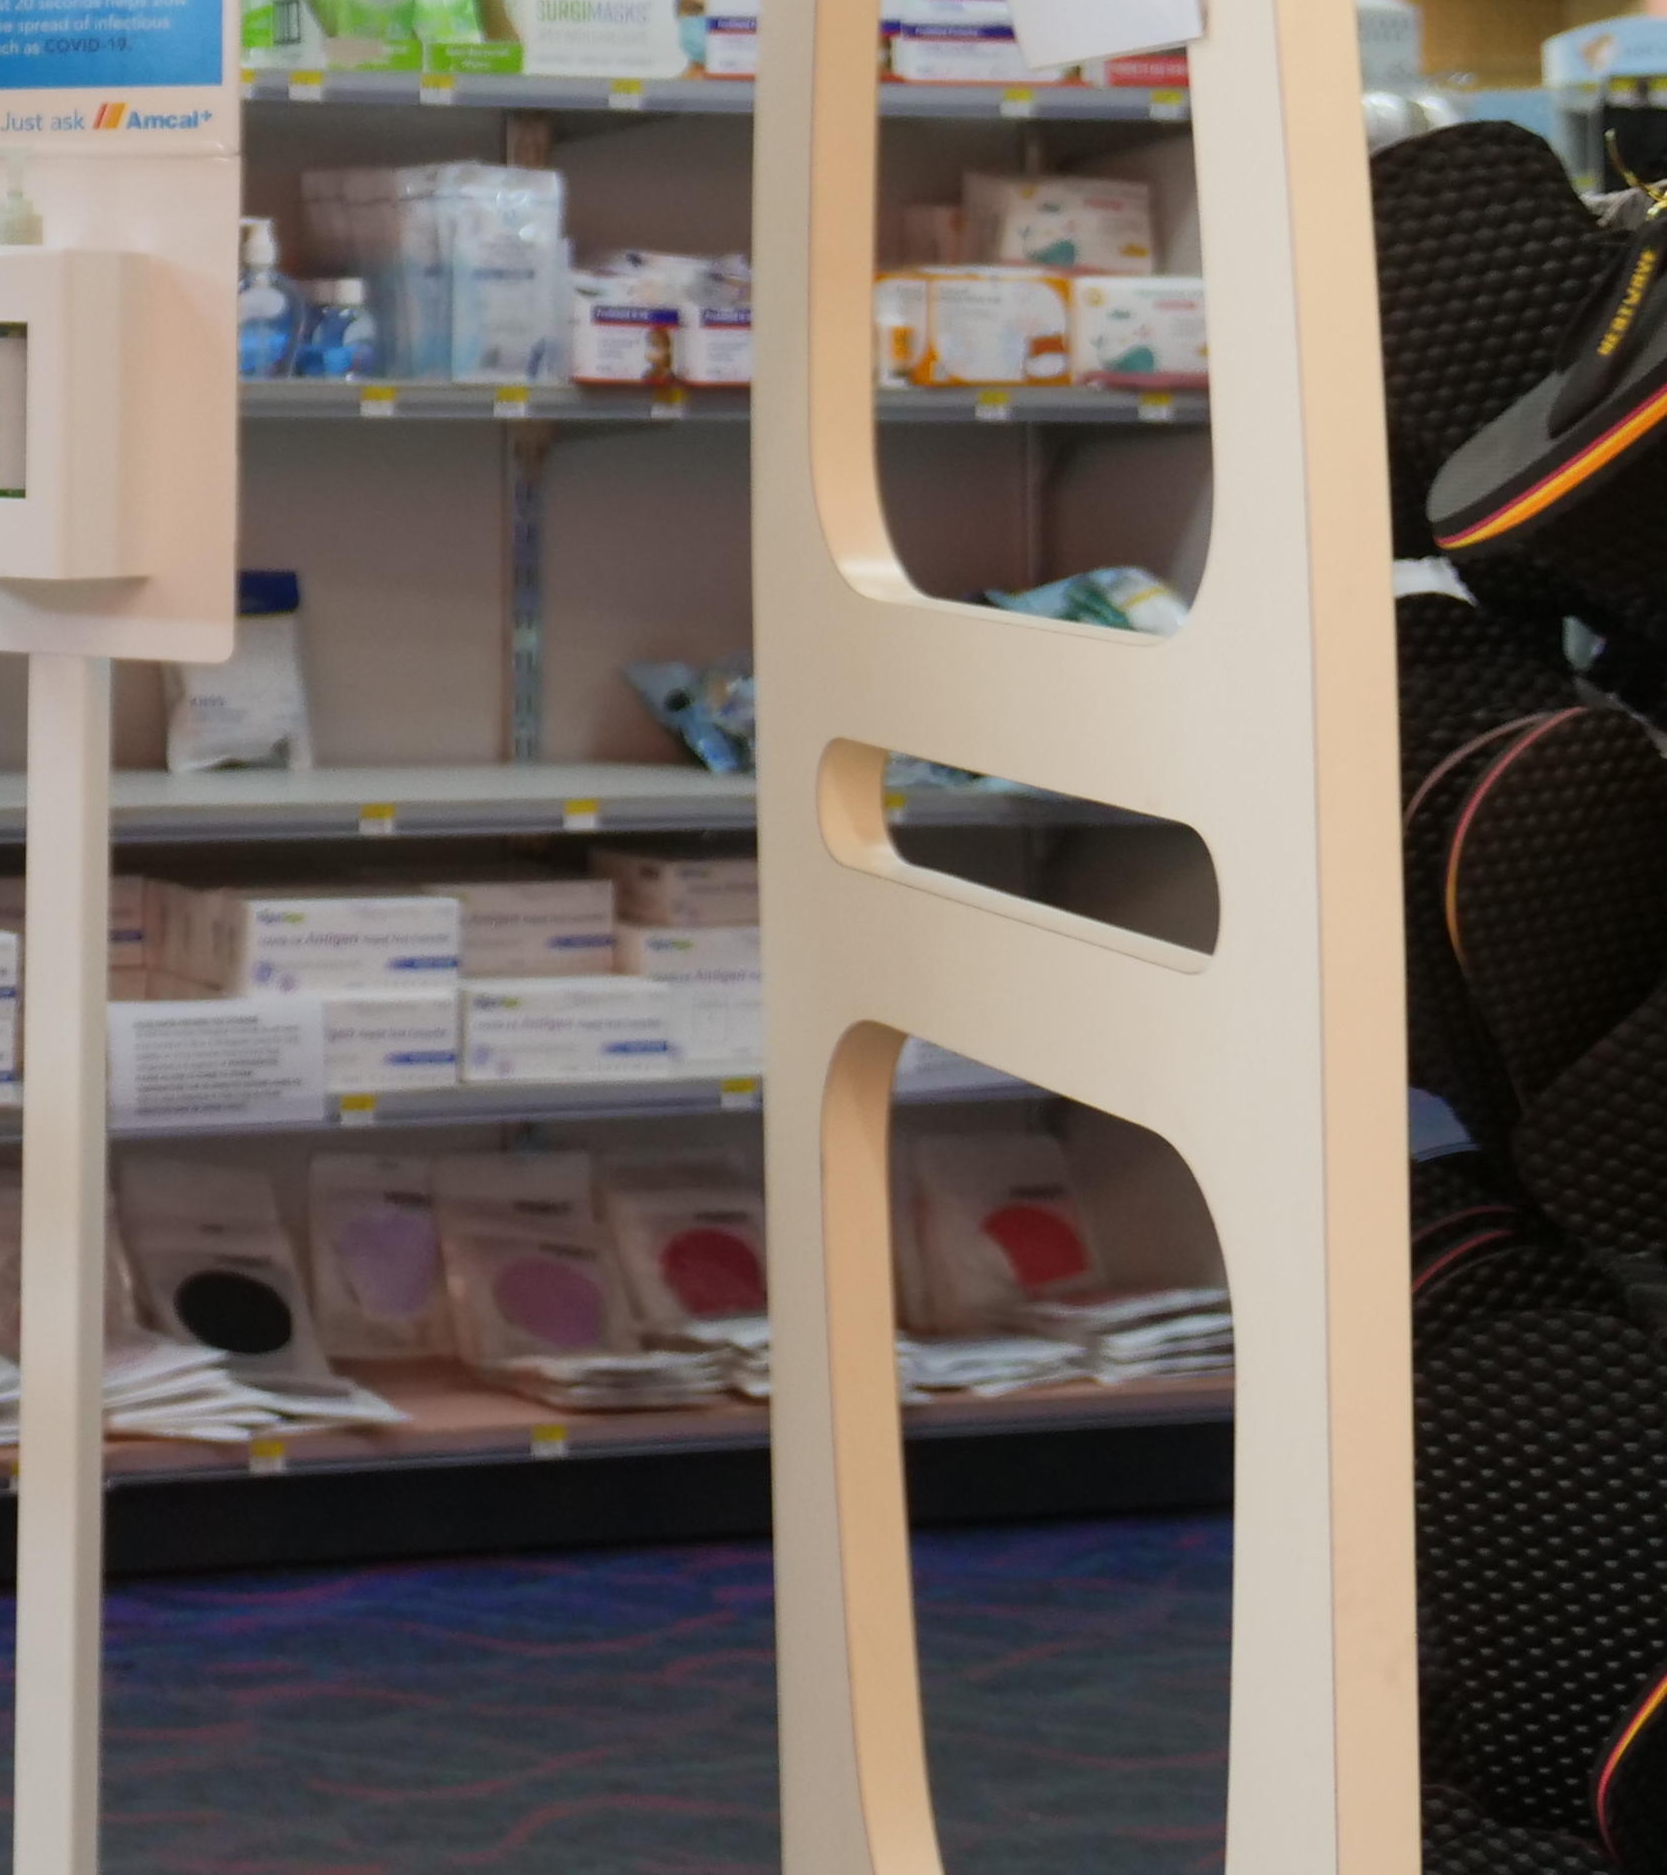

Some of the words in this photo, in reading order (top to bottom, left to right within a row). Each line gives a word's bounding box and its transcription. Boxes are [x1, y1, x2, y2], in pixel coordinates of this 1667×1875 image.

[18, 17, 67, 34] spread
[73, 16, 91, 30] of
[95, 14, 171, 30] infectious
[22, 43, 41, 56] as
[0, 111, 43, 132] Just
[50, 109, 85, 131] ask
